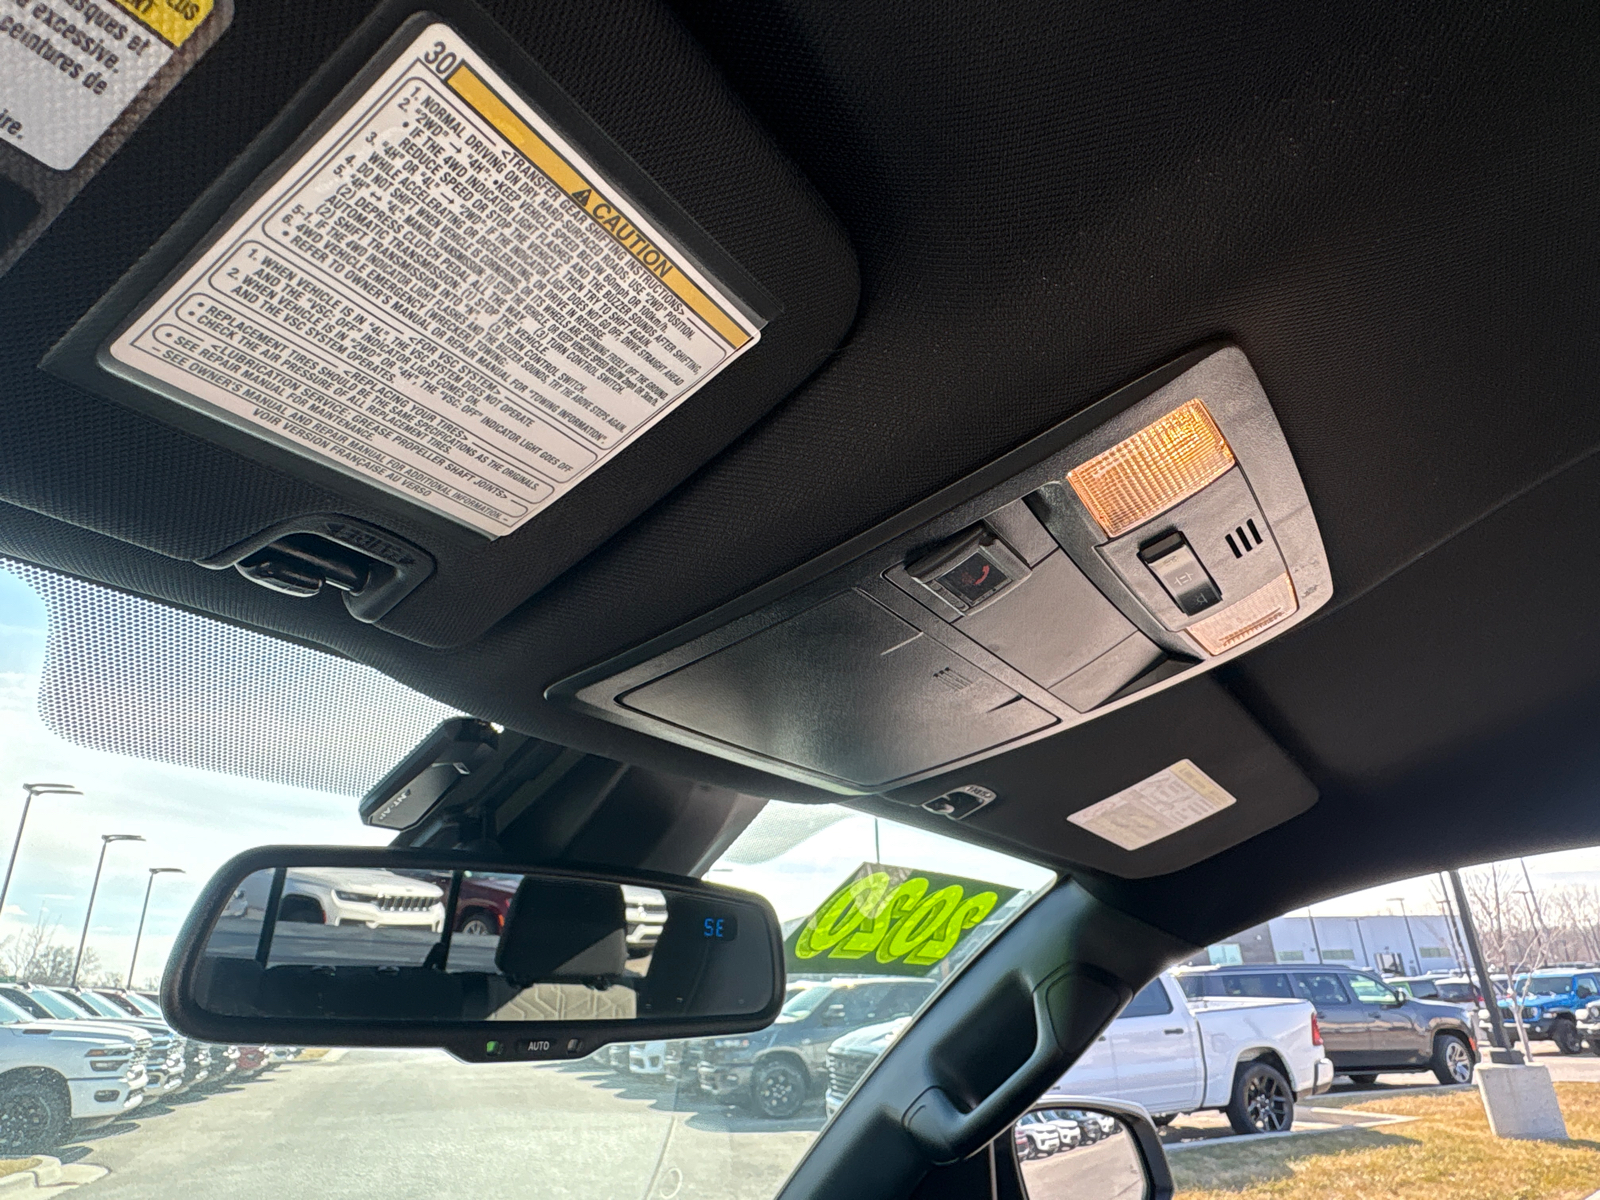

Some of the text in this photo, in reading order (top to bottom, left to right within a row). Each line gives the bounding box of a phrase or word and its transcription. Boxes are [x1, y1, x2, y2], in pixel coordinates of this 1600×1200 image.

[0, 15, 108, 95] ceintures de
[32, 3, 119, 73] excessive.
[127, 35, 150, 56] et
[423, 41, 457, 74] 30
[397, 97, 411, 113] 2.
[518, 200, 554, 233] VEHICLE
[551, 228, 579, 253] SPEED
[576, 250, 606, 276] BELOW
[602, 273, 630, 299] 60mph
[627, 295, 642, 309] OR
[398, 137, 652, 348] REDUCE SPEED OR STOP THE VEHICLE, THEN TRY TO SHIFT AGAIN.
[408, 125, 425, 139] IF
[421, 136, 446, 159] THE
[442, 155, 468, 178] 4WD
[464, 174, 515, 217] INDICATOR
[511, 211, 539, 235] LIGHT
[535, 232, 573, 265] FLASHES
[569, 261, 590, 280] AND
[587, 276, 606, 294] THE
[601, 289, 632, 316] BUZZER
[628, 312, 658, 337] SOUNDS
[653, 333, 677, 353] AFTER
[410, 86, 422, 101] 1.
[420, 95, 465, 139] NORMAL
[464, 134, 507, 174] DRIVING
[503, 169, 522, 187] ON
[517, 181, 540, 205] DRY,
[600, 253, 630, 283] ROADS:
[627, 277, 647, 296] USE
[663, 310, 695, 340] POSITION.
[559, 199, 588, 225] GEAR
[585, 222, 627, 261] SHIFTING
[592, 203, 674, 277] CAUTION
[281, 213, 294, 227] 6.
[295, 223, 324, 244] 4WD
[323, 239, 369, 273] VEHICLE
[366, 269, 427, 311] EMERGENCY
[473, 339, 508, 367] TOWING:
[324, 194, 549, 356] AUTOMATIC TRANSMISSION: (1) STOP THE VEHICLE.
[335, 183, 625, 395] (2) DEPRESS CLUTCH PEDAL ALL THE WAY. (3) TURN CONTROL SWITCH.
[230, 285, 396, 383] AND THE VSC SYSTEM OPERATES.
[247, 248, 258, 261] 1.
[260, 255, 297, 282] WHEN
[296, 277, 342, 310] VEHICLE
[339, 305, 355, 317] IS
[351, 313, 368, 326] IN
[390, 336, 412, 352] THE
[409, 347, 430, 363] VSC
[427, 359, 464, 384] SYSTEM
[461, 379, 486, 397] DOES
[482, 393, 503, 407] NOT
[499, 403, 535, 427] OPERATE
[437, 351, 460, 368] VSC
[162, 349, 189, 366] SEE
[242, 388, 288, 415] MANUAL
[288, 411, 313, 426] AND
[311, 422, 349, 444] REPAIR
[347, 440, 386, 463] MANUAL
[385, 459, 406, 471] FOR
[404, 468, 451, 495] ADDITIONAL
[173, 335, 375, 441] SEE REPAIR MANUAL FOR MAINTENANCE.
[196, 314, 452, 454] CHECK THE AIR PRESSURE OF ALL REPLACEMENT TIRES.
[206, 305, 287, 352] REPLACEMENT
[287, 349, 319, 370] TIRES
[317, 366, 358, 391] SHOULD
[355, 387, 373, 399] BE
[371, 395, 391, 409] THE
[388, 405, 417, 423] SAME
[414, 419, 477, 456] SPECIFICATIONS
[474, 453, 489, 463] AS
[487, 459, 504, 471] THE
[409, 404, 437, 423] YOUR
[252, 408, 282, 426] VOIR
[282, 422, 330, 448] VERSION
[384, 472, 402, 482] AU
[401, 479, 432, 496] VERSO
[300, 388, 351, 417] SERVICE:
[351, 414, 393, 439] GREASE
[391, 435, 445, 466] PROPELLER
[444, 463, 476, 481] SHAFT
[704, 918, 724, 937] SE
[528, 1041, 550, 1051] AUTO
